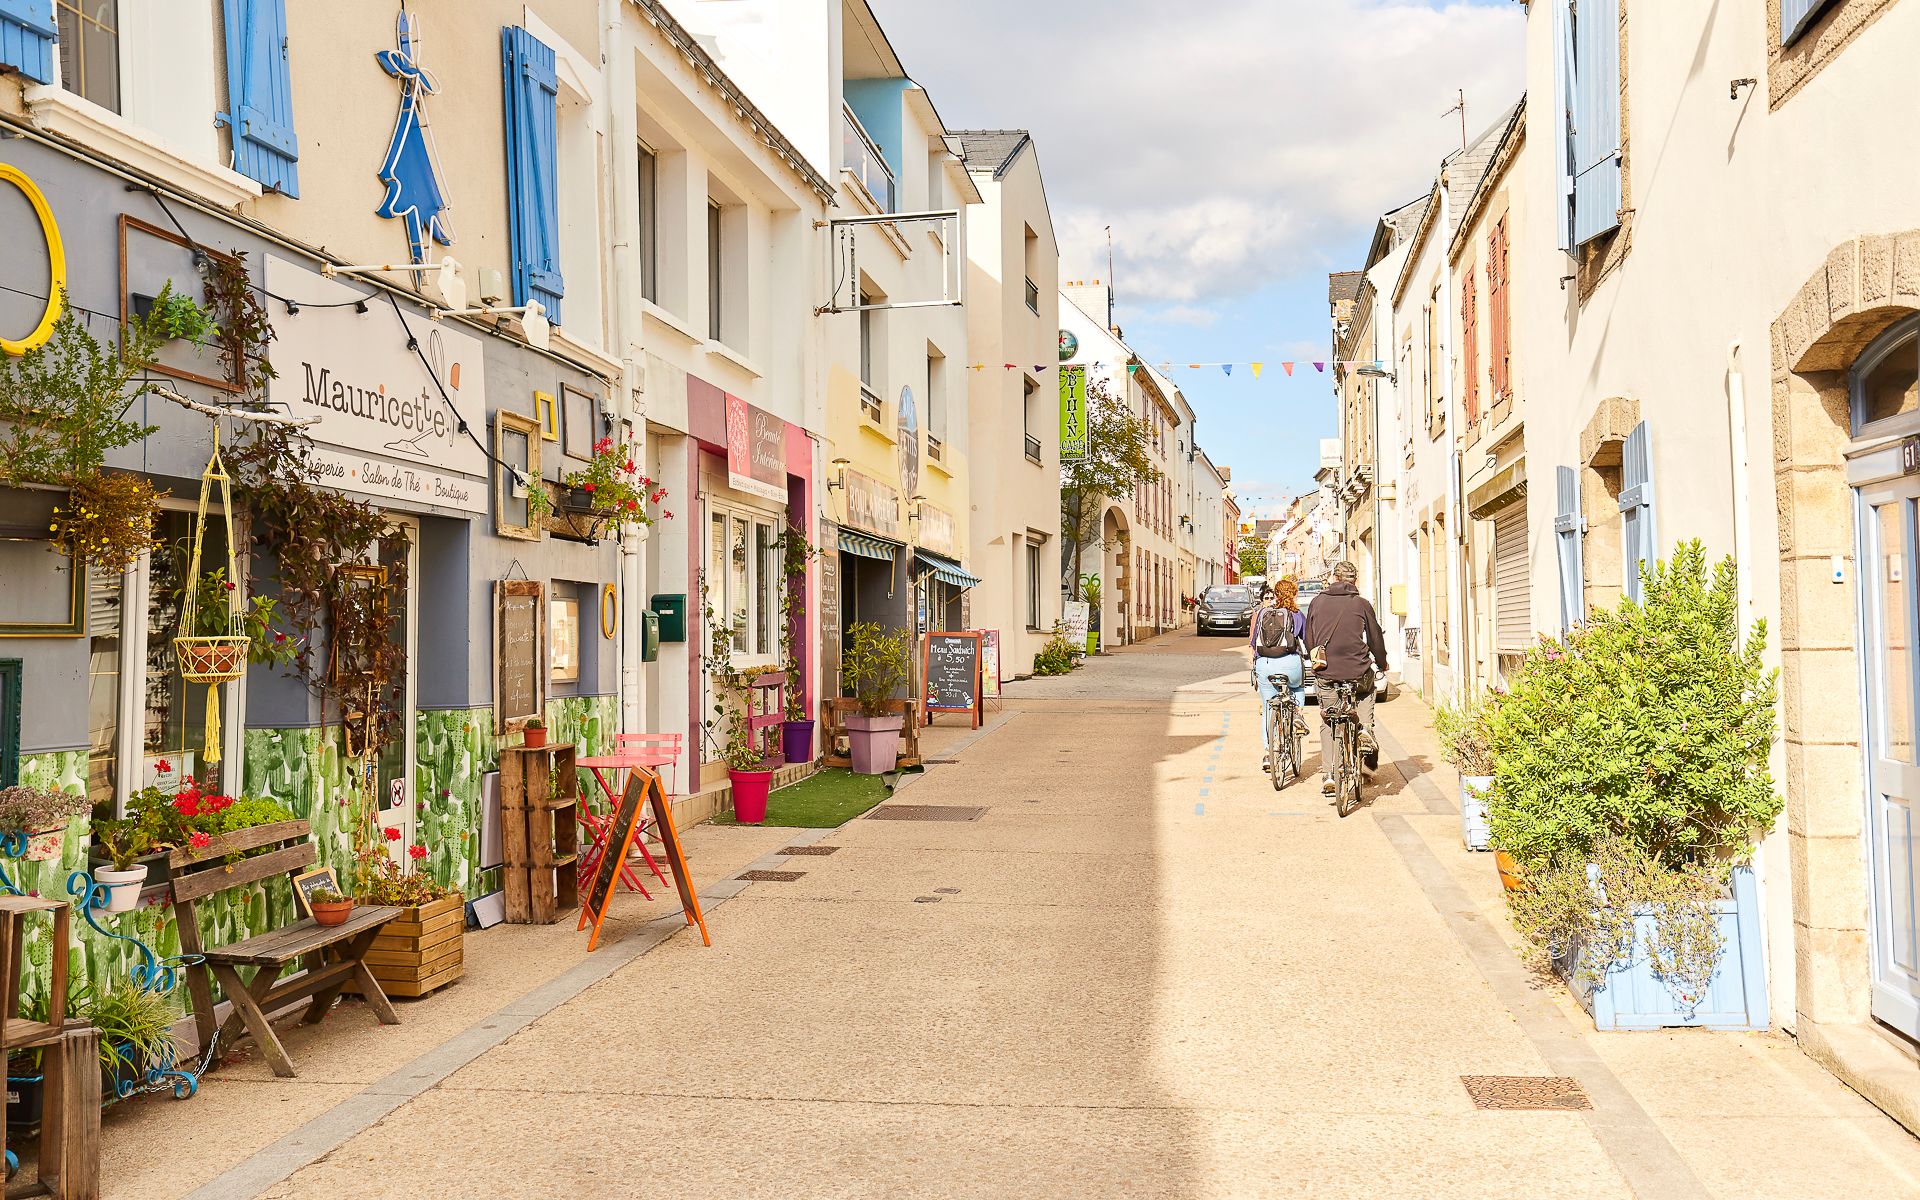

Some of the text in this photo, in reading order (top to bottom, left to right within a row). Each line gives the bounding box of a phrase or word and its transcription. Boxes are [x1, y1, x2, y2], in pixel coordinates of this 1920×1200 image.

[302, 361, 445, 438] Mauricette
[1066, 373, 1078, 438] BIHAN
[303, 450, 470, 505] Crêperie Salon de Thé Boutique
[1904, 444, 1915, 468] 61
[930, 644, 948, 654] Menu
[948, 641, 975, 655] Sandwich
